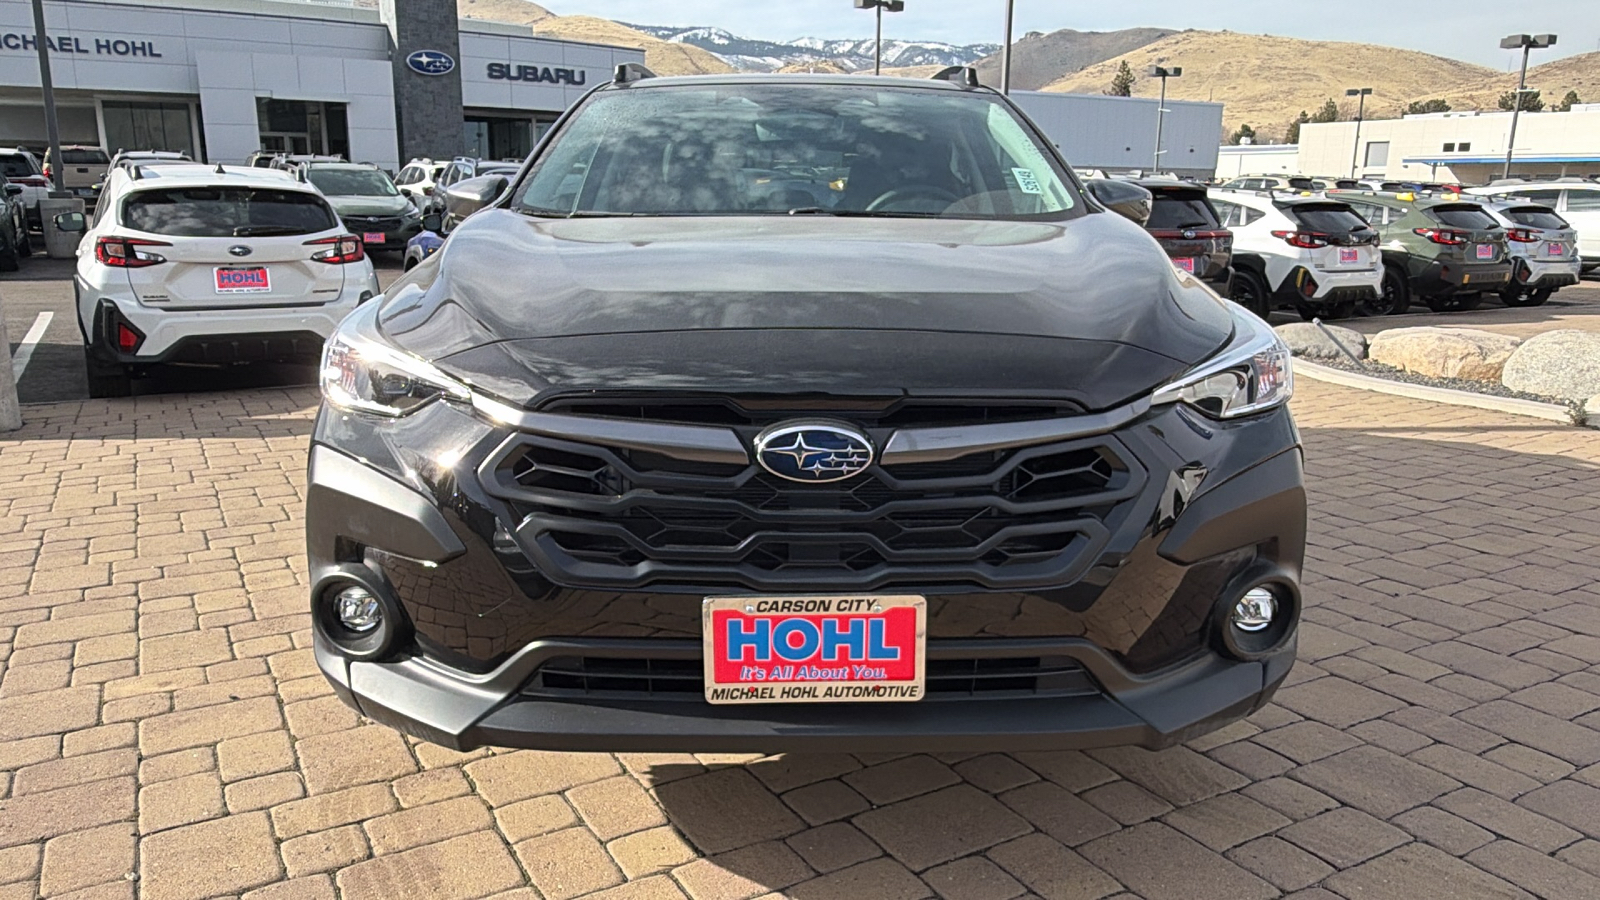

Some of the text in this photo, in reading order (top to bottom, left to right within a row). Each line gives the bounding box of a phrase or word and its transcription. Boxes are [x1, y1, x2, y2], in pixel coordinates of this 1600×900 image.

[95, 38, 162, 58] HOHL
[487, 62, 585, 86] SUBARU
[220, 272, 264, 283] HOHL
[756, 599, 876, 613] CARSON CITY
[727, 618, 900, 661] HOHL
[740, 665, 887, 680] It's All About You.
[711, 686, 919, 700] MICHAEL HOHL AUTOMOTIVE
